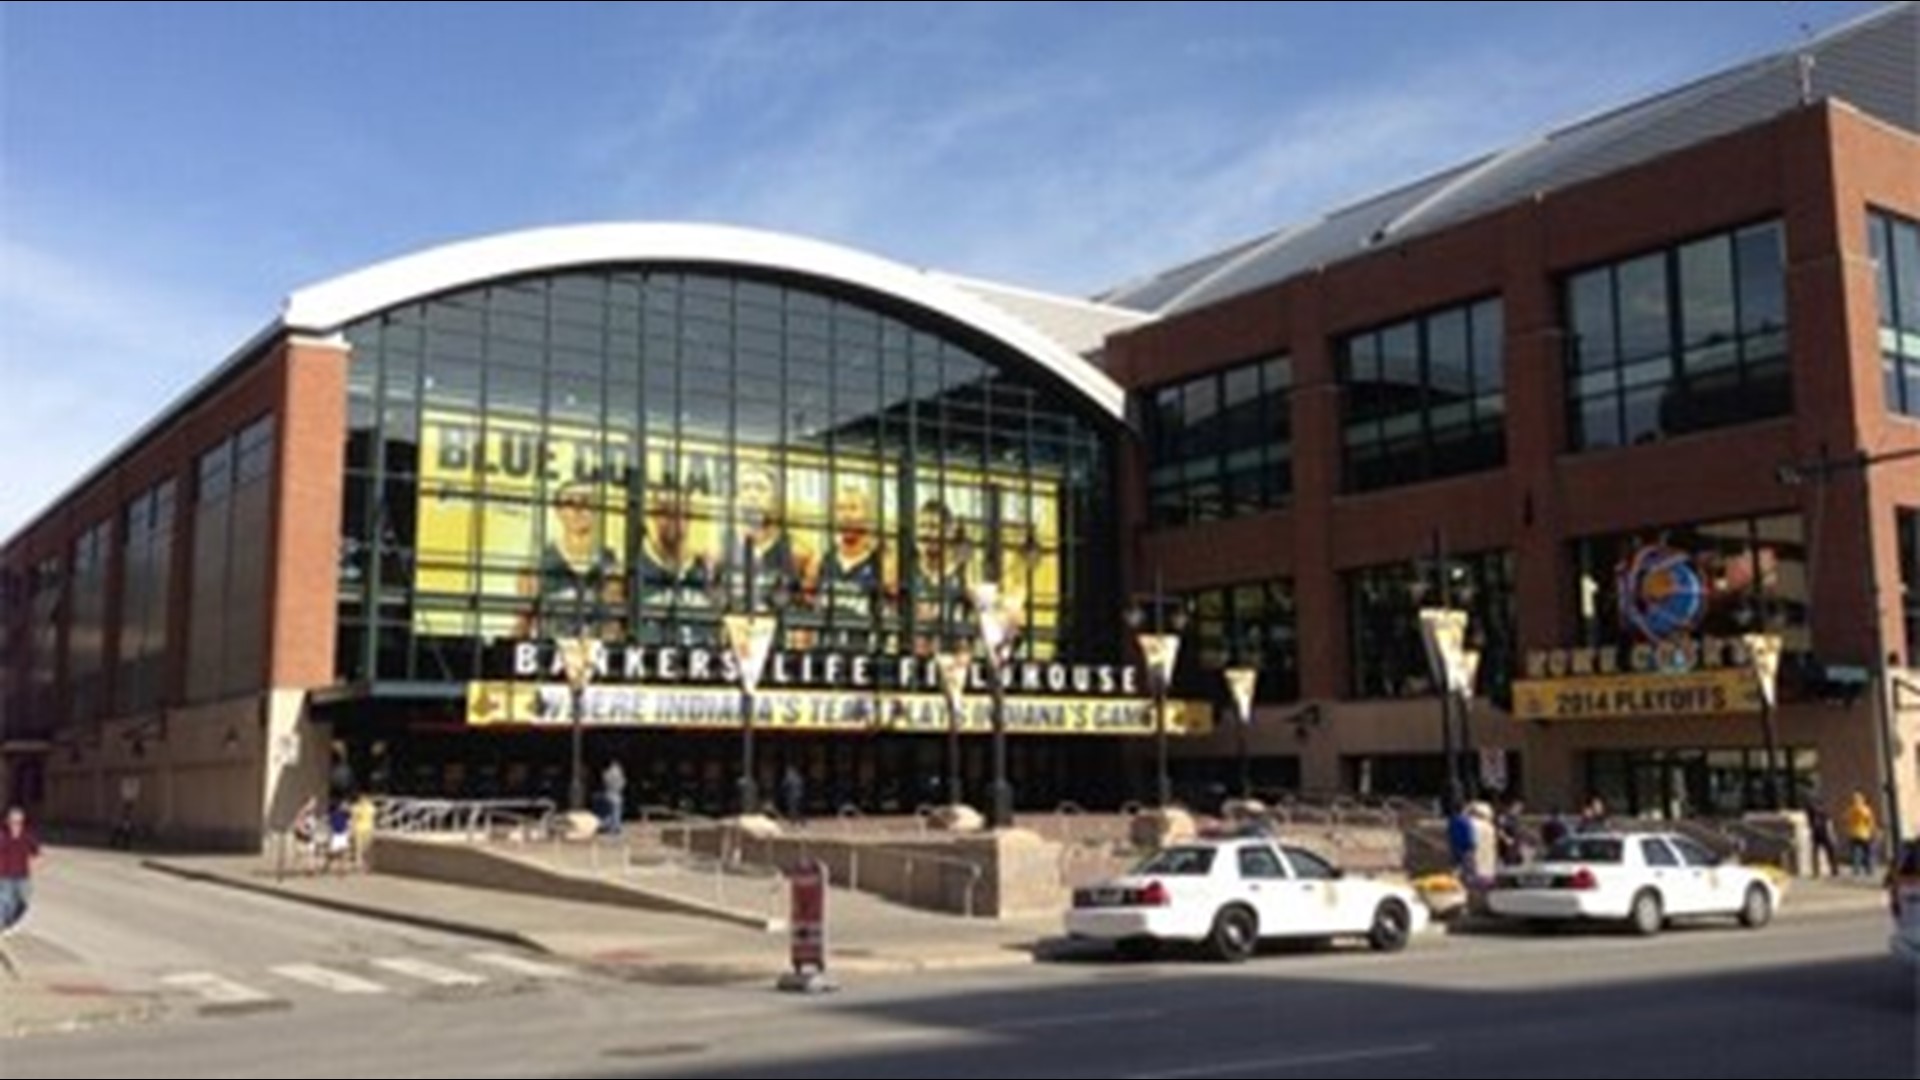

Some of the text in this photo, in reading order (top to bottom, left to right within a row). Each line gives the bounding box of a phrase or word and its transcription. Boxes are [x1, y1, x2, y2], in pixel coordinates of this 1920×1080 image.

[439, 430, 560, 480] BLUE
[573, 441, 736, 498] COLAR
[514, 644, 1136, 692] BANKERS LIFE FILDHOUSE
[655, 693, 802, 722] INDIAA'S
[1556, 685, 1726, 715] 2014 PLAYOFFS
